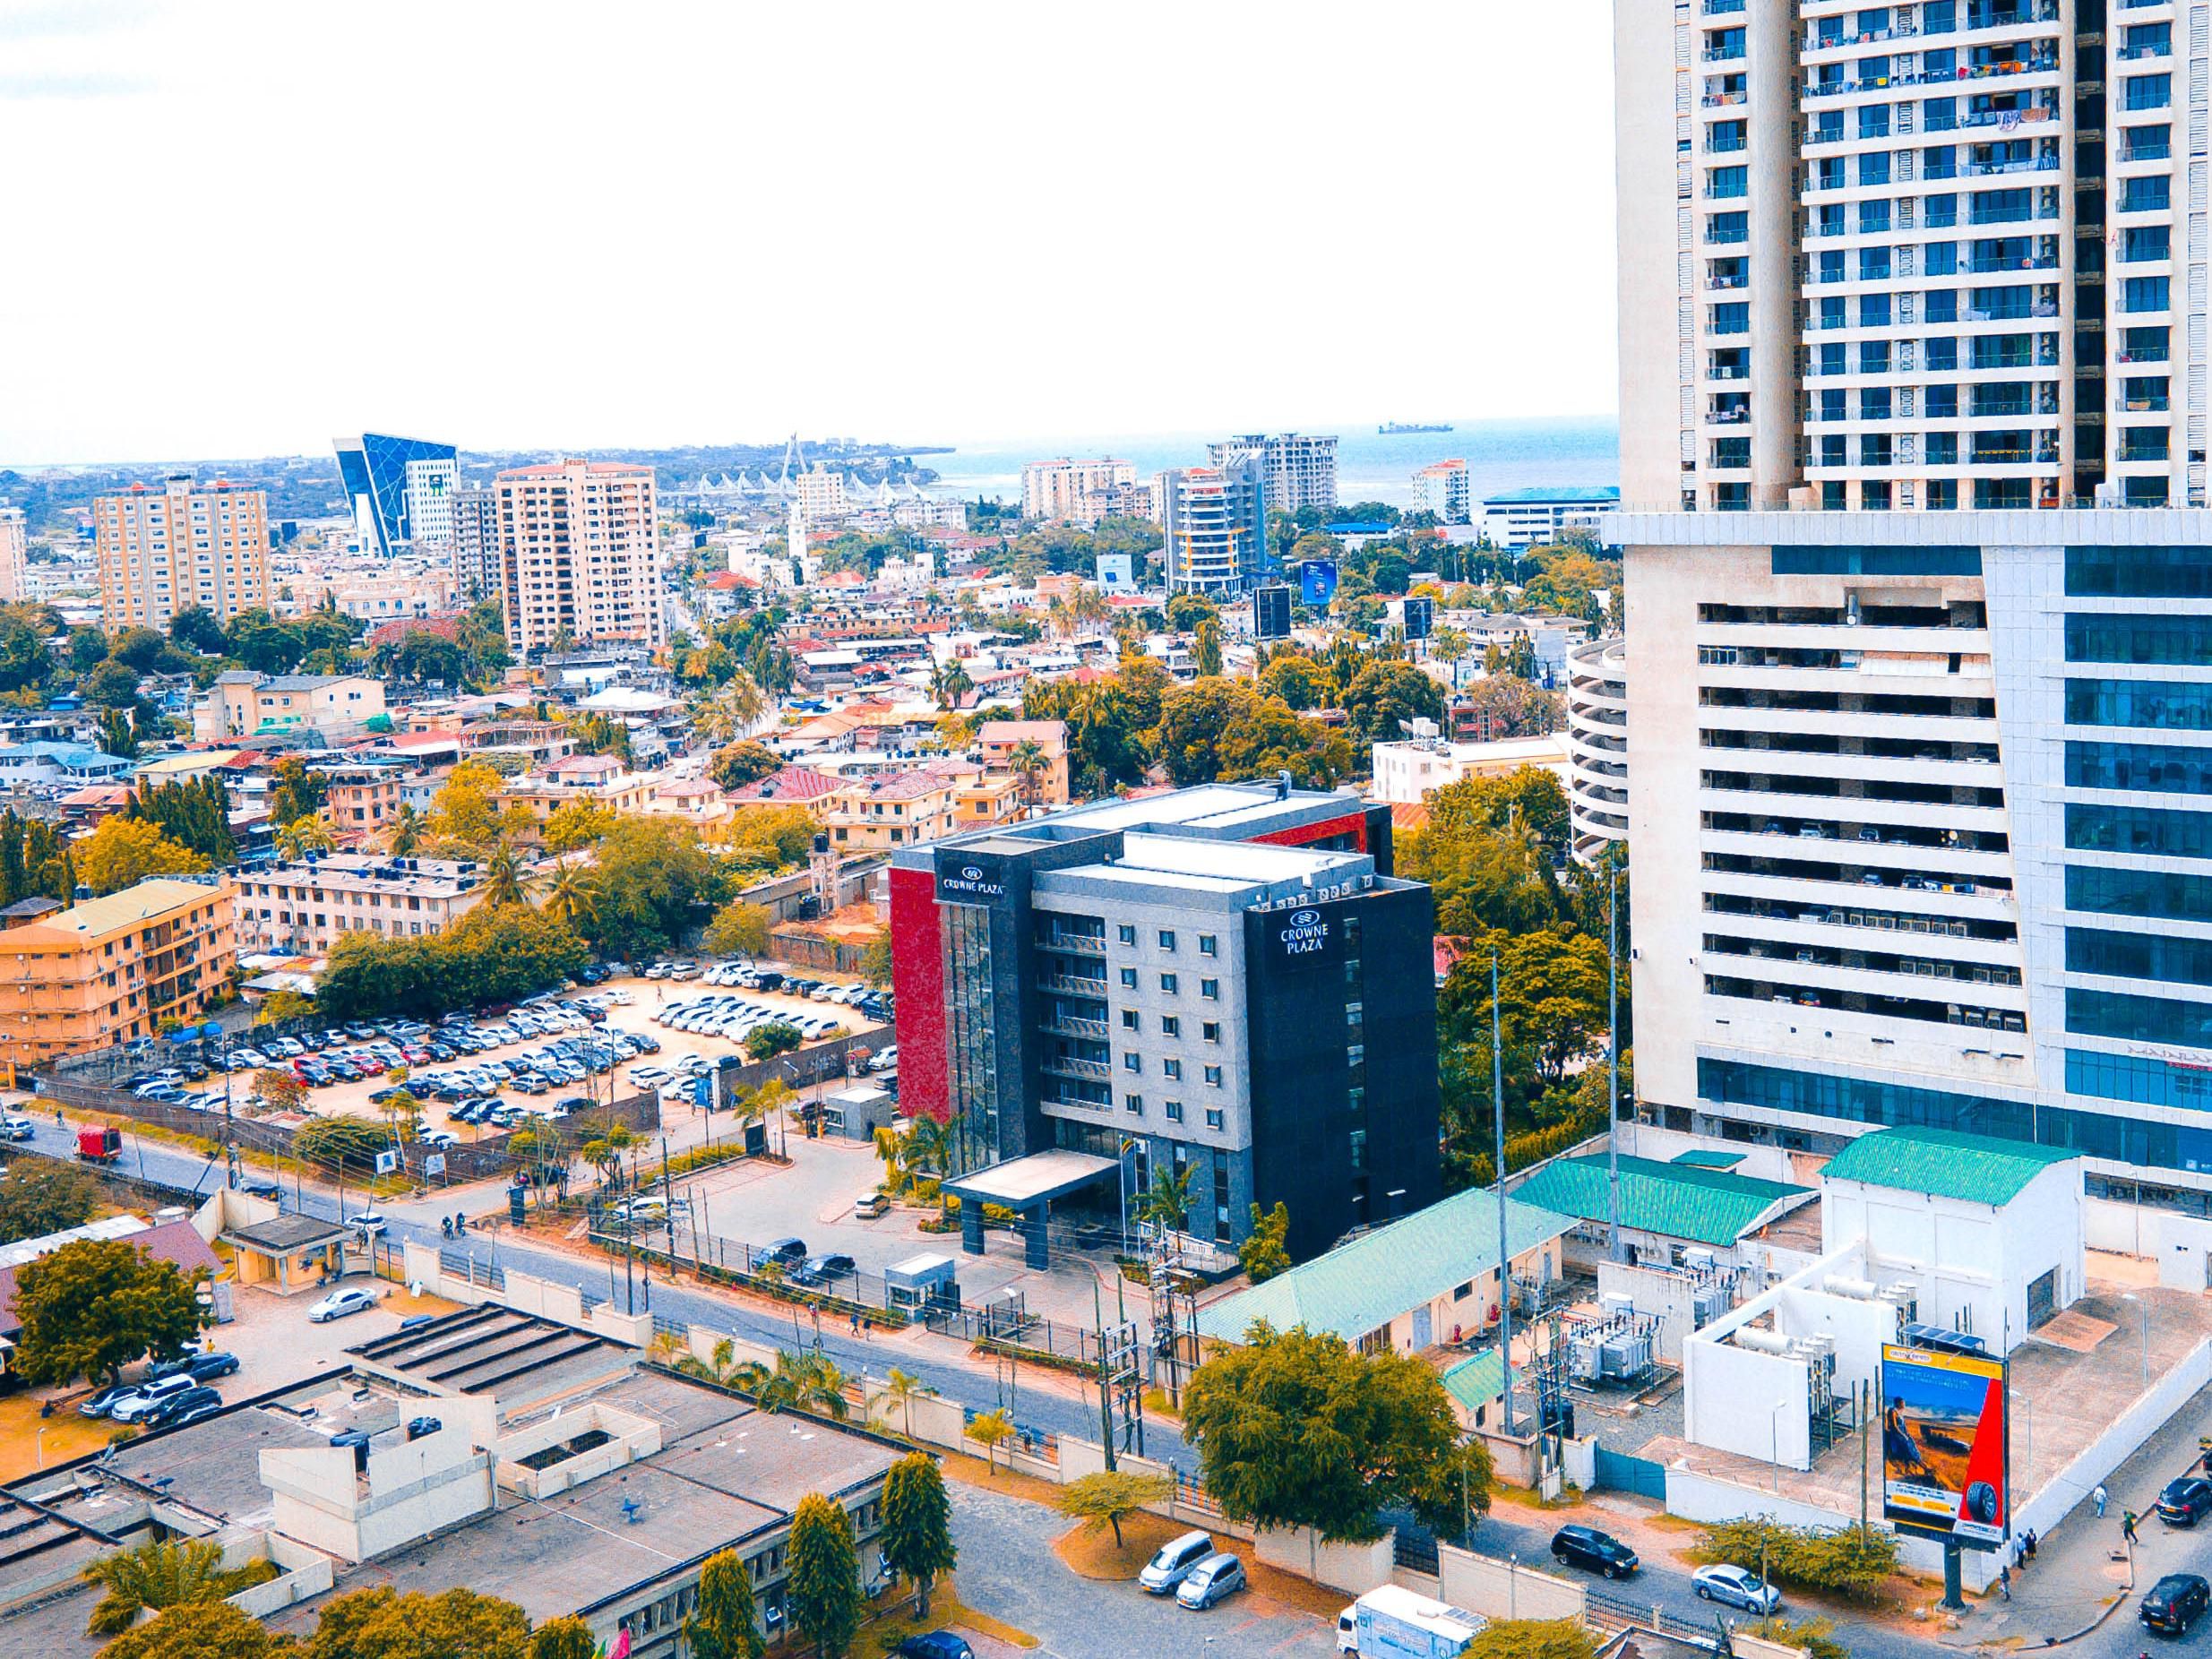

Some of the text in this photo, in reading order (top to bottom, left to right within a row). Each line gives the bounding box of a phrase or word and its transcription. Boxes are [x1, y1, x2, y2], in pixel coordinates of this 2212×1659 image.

[943, 879, 1003, 895] CROWNE PLAZA
[1281, 924, 1328, 941] CROWNE
[1287, 939, 1322, 955] PLAZA
